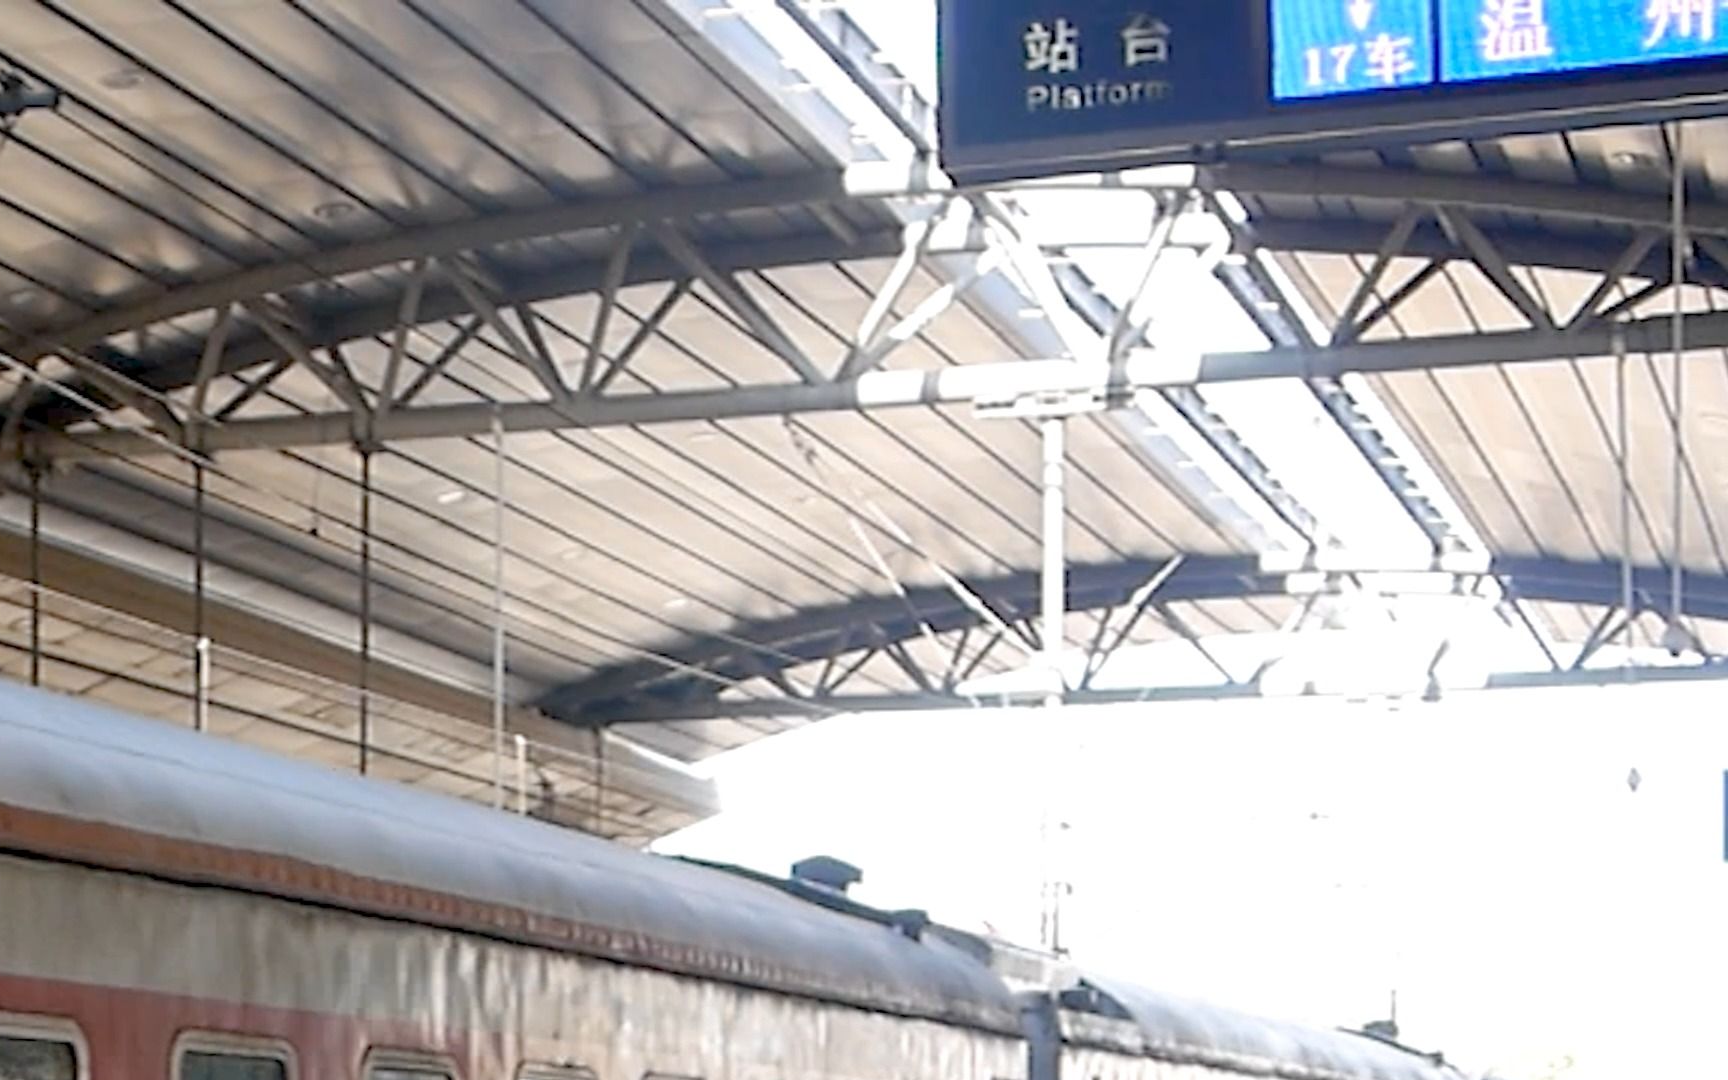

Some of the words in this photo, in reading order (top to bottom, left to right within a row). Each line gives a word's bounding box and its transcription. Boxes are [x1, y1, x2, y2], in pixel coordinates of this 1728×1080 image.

[1024, 13, 1170, 73] 站台
[1305, 33, 1415, 86] 17车
[1027, 79, 1173, 111] Platform
